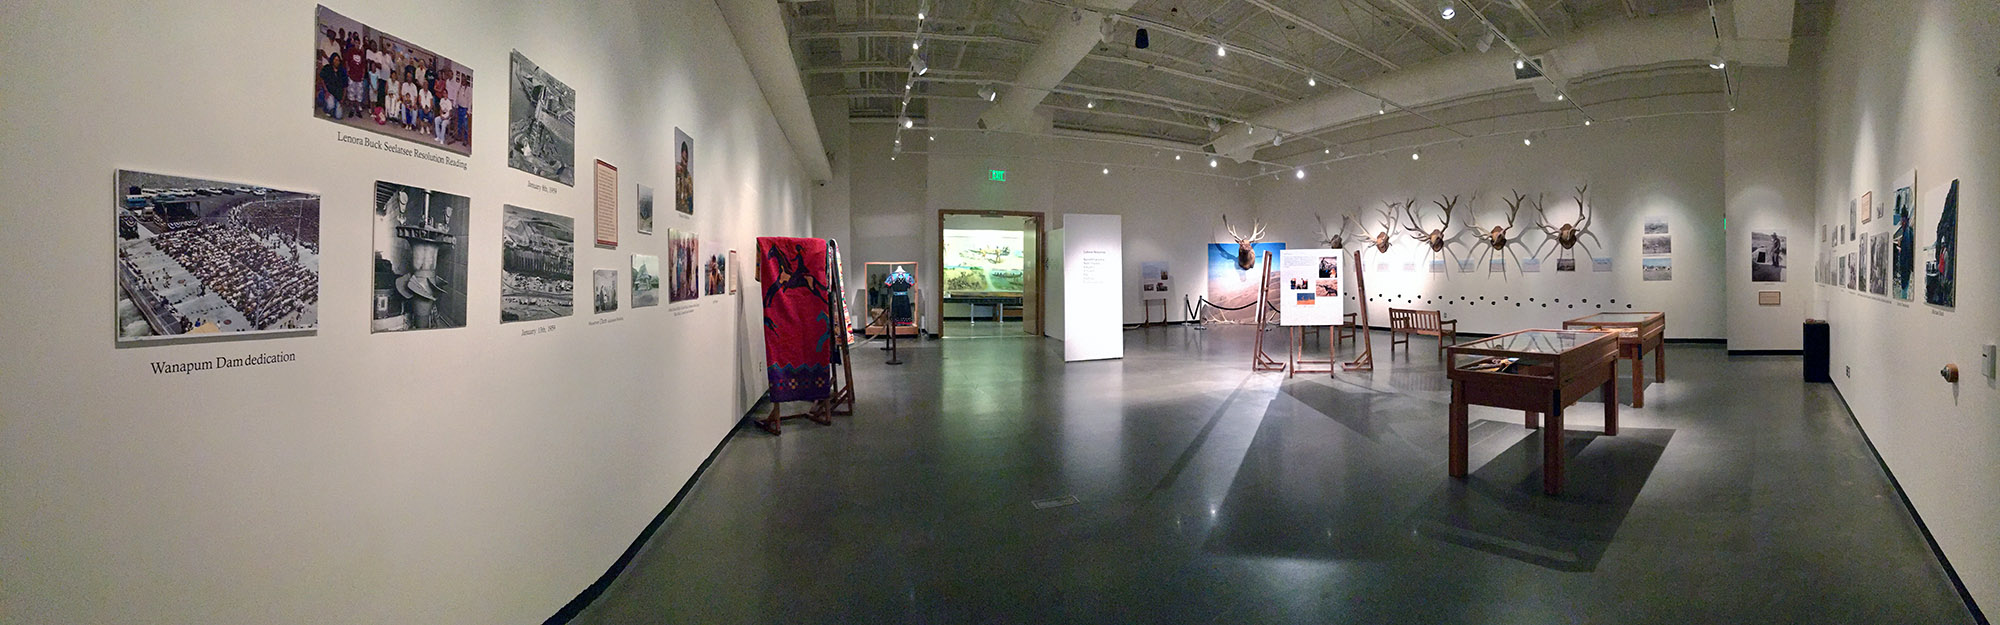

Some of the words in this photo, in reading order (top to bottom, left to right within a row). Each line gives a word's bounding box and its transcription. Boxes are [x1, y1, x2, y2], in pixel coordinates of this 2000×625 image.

[337, 131, 364, 146] Lenora
[364, 137, 383, 150] Buck
[384, 142, 413, 157] Seelatsee
[414, 148, 445, 164] Resolution
[445, 156, 468, 171] Reading
[527, 180, 542, 192] January
[521, 329, 537, 337] January
[150, 360, 213, 375] Wanapum
[216, 356, 243, 369] Dam
[244, 351, 296, 366] dedication
